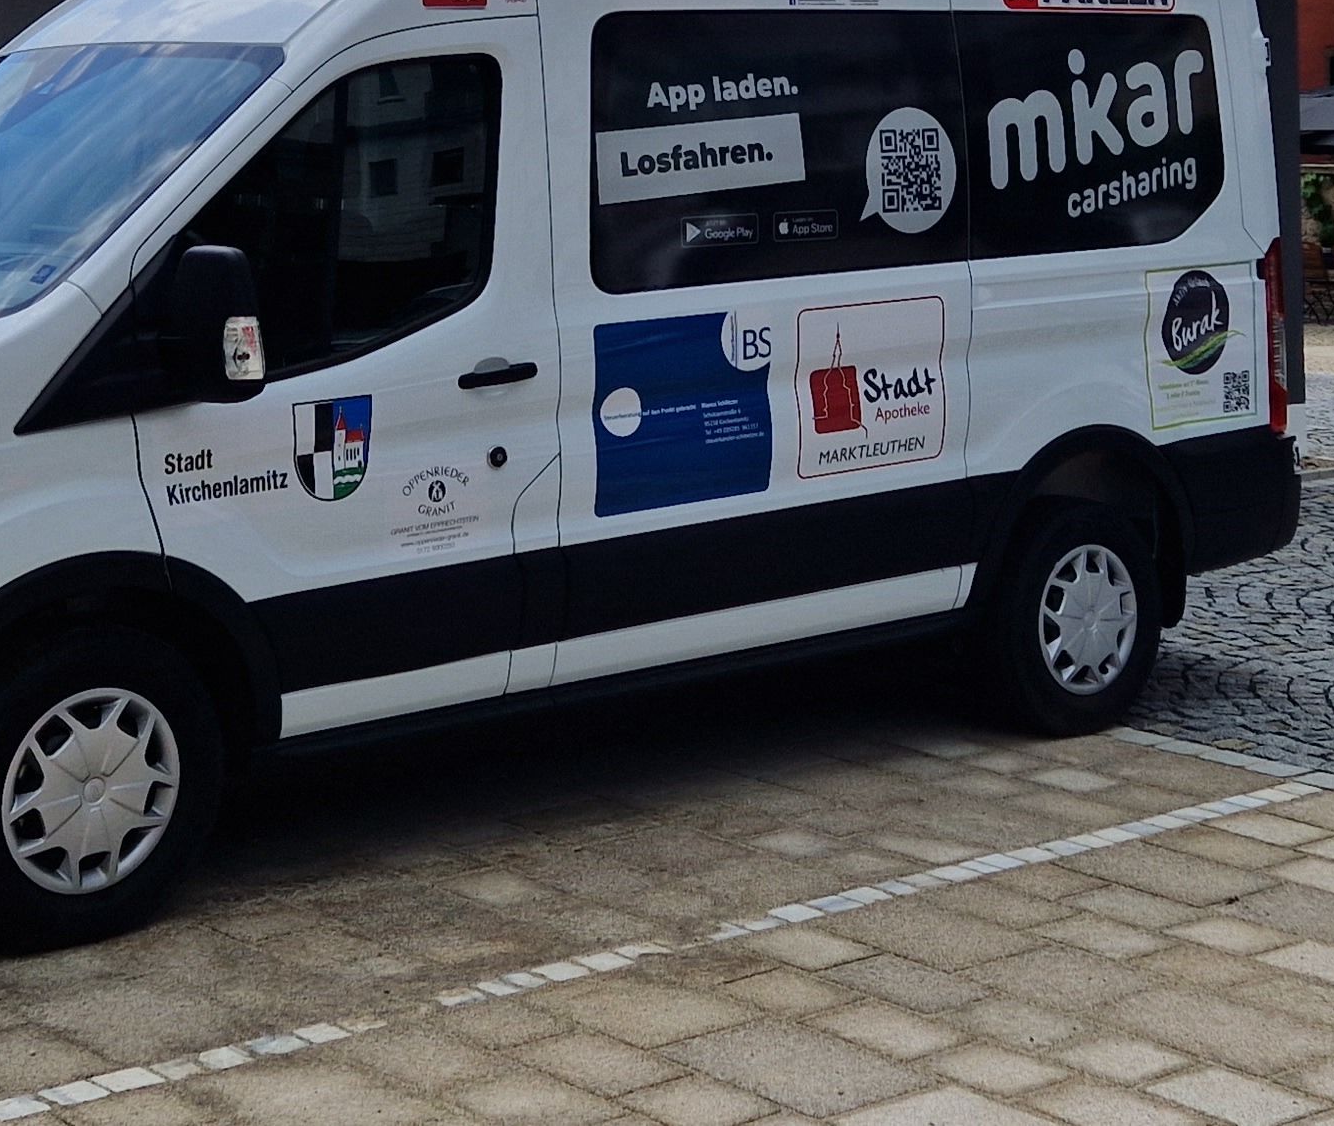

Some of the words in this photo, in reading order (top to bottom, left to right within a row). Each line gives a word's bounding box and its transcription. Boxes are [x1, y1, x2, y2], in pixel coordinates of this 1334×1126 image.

[646, 81, 706, 112] App
[712, 73, 799, 102] laden.
[987, 48, 1204, 190] mikar
[620, 142, 773, 177] Losfahren.
[1067, 157, 1197, 217] carsharing
[704, 227, 736, 241] Google
[736, 226, 753, 239] Play
[792, 224, 810, 236] App
[811, 222, 834, 234] Store
[1171, 290, 1223, 352] Burak
[743, 326, 771, 361] BS
[863, 367, 936, 403] Stadt
[875, 402, 931, 425] Apotheke
[164, 449, 213, 475] Stadt
[818, 436, 926, 465] MARKTLEUTHEN
[166, 470, 289, 506] Kirchenlamitz
[402, 466, 470, 496] OPPENRIEDER
[417, 500, 456, 517] GRANIT
